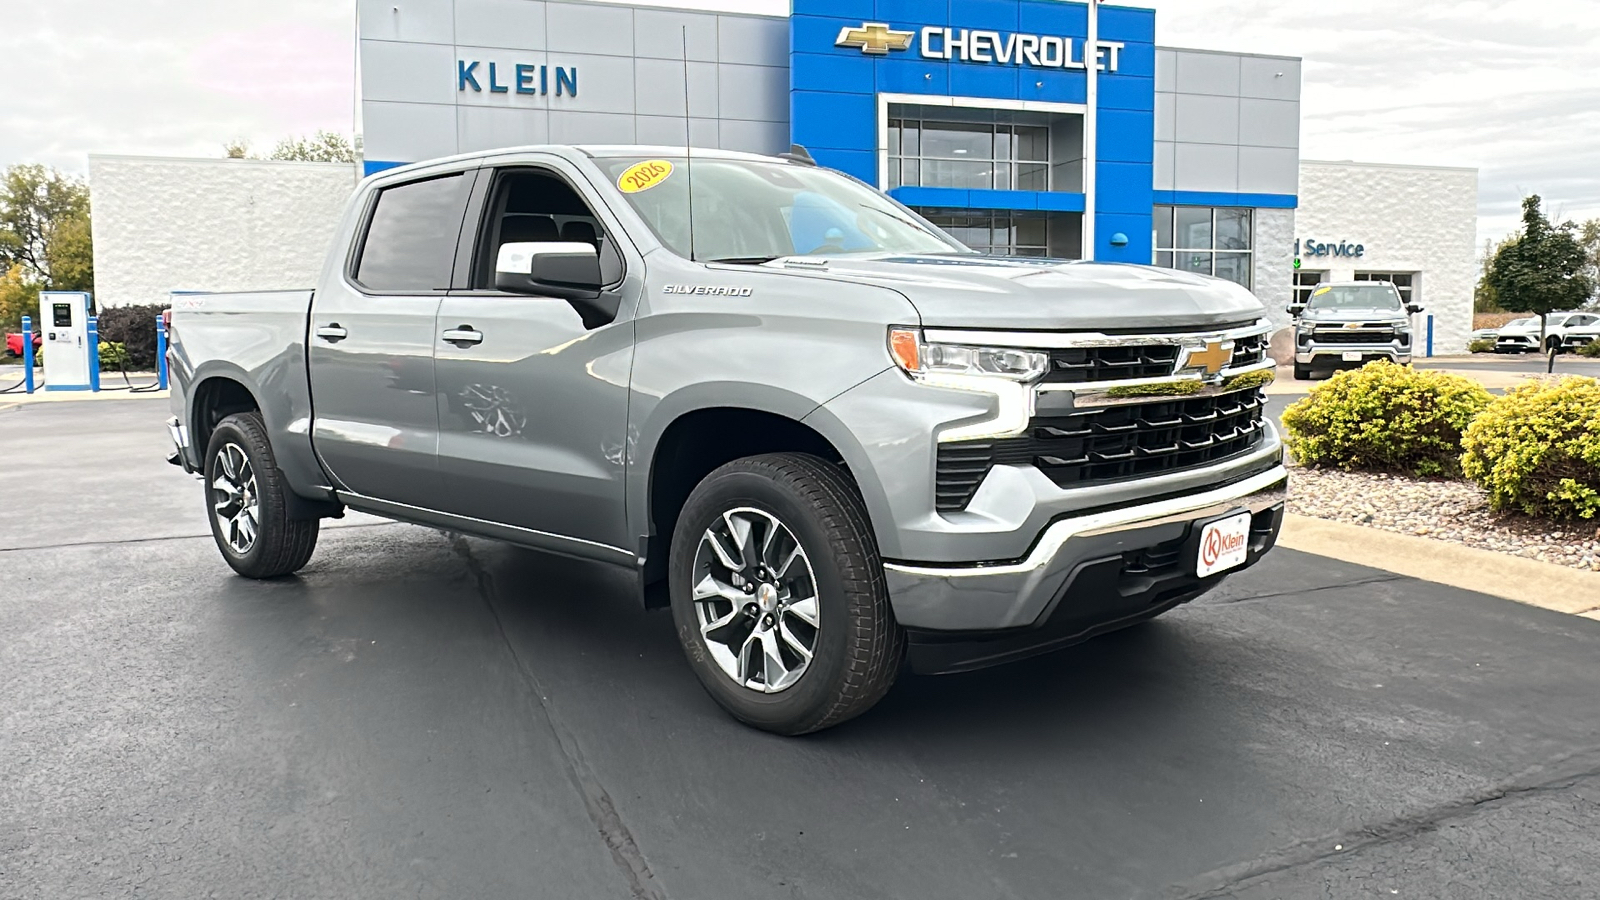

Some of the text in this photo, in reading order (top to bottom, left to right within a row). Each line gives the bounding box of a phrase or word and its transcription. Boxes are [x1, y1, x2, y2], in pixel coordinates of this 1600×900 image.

[921, 26, 1125, 72] CHEVROLET
[458, 60, 578, 98] KLEIN
[626, 162, 666, 188] 2026
[1304, 239, 1365, 258] Service
[663, 284, 753, 297] SILVERADO
[1221, 533, 1245, 552] Klein
